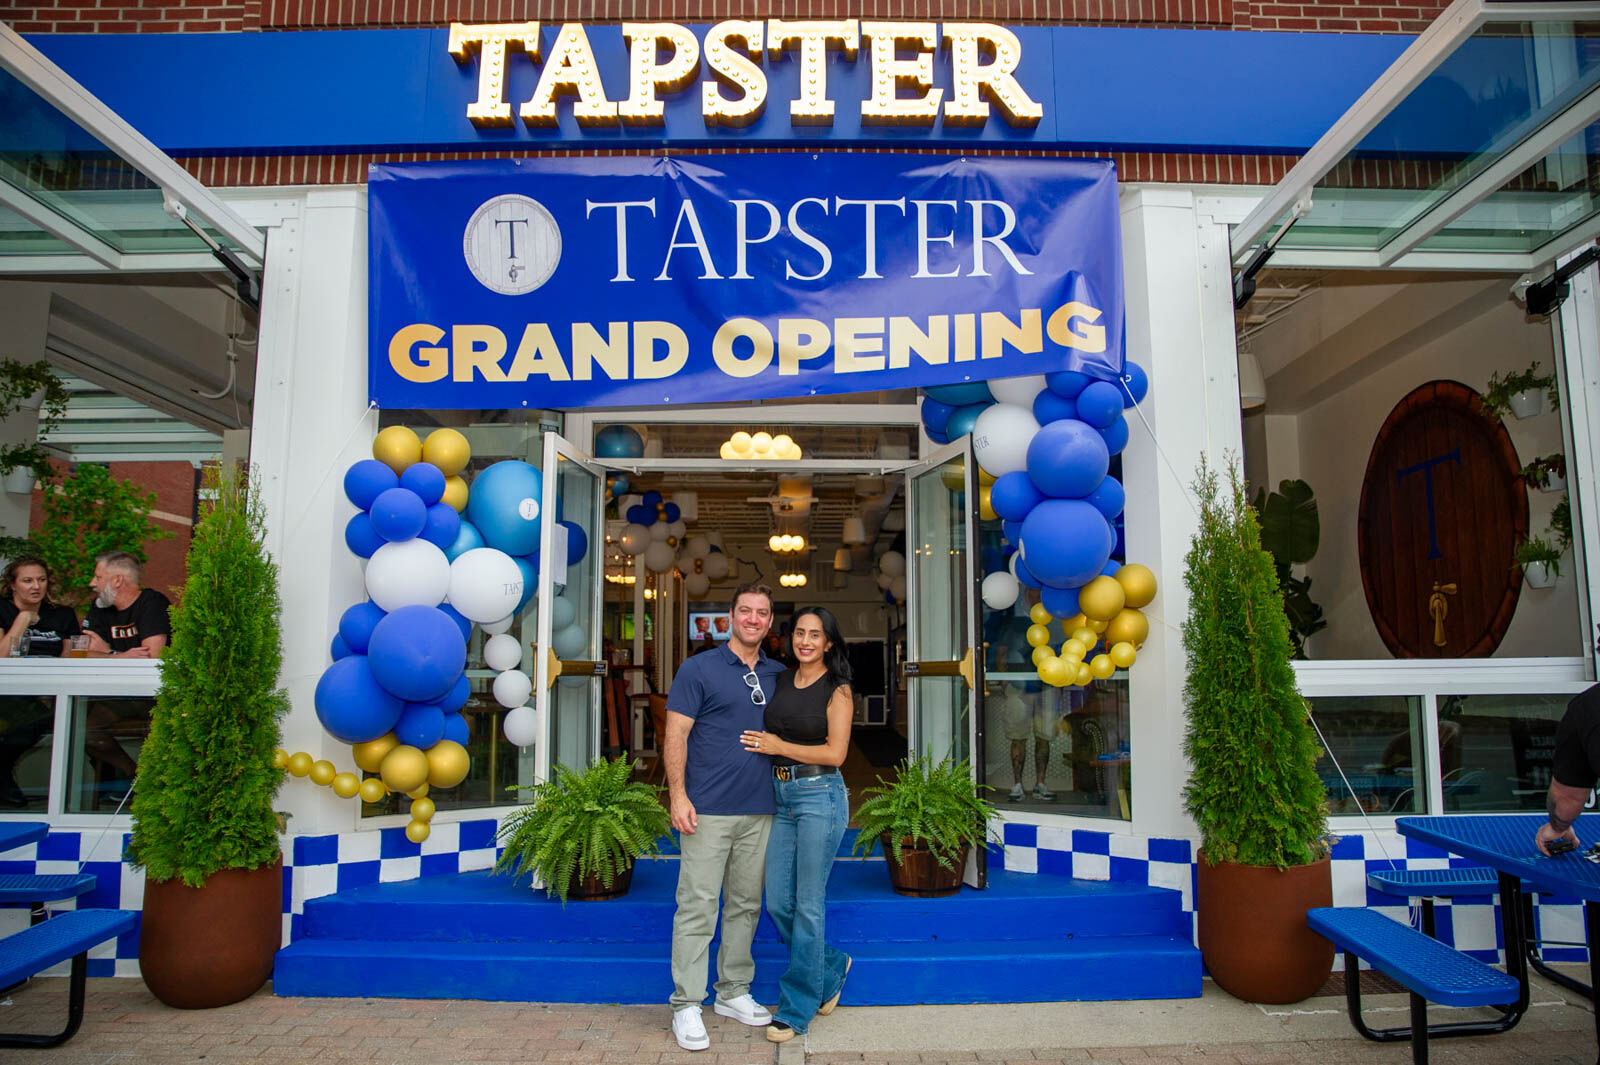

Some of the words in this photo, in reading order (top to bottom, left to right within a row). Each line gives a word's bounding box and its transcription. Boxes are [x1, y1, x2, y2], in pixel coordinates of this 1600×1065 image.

[448, 19, 1043, 121] TAPSTER
[495, 218, 528, 260] T
[586, 196, 1035, 282] TAPSTER
[388, 321, 690, 383] GRAND
[712, 301, 1107, 378] OPENING
[1396, 447, 1461, 560] T
